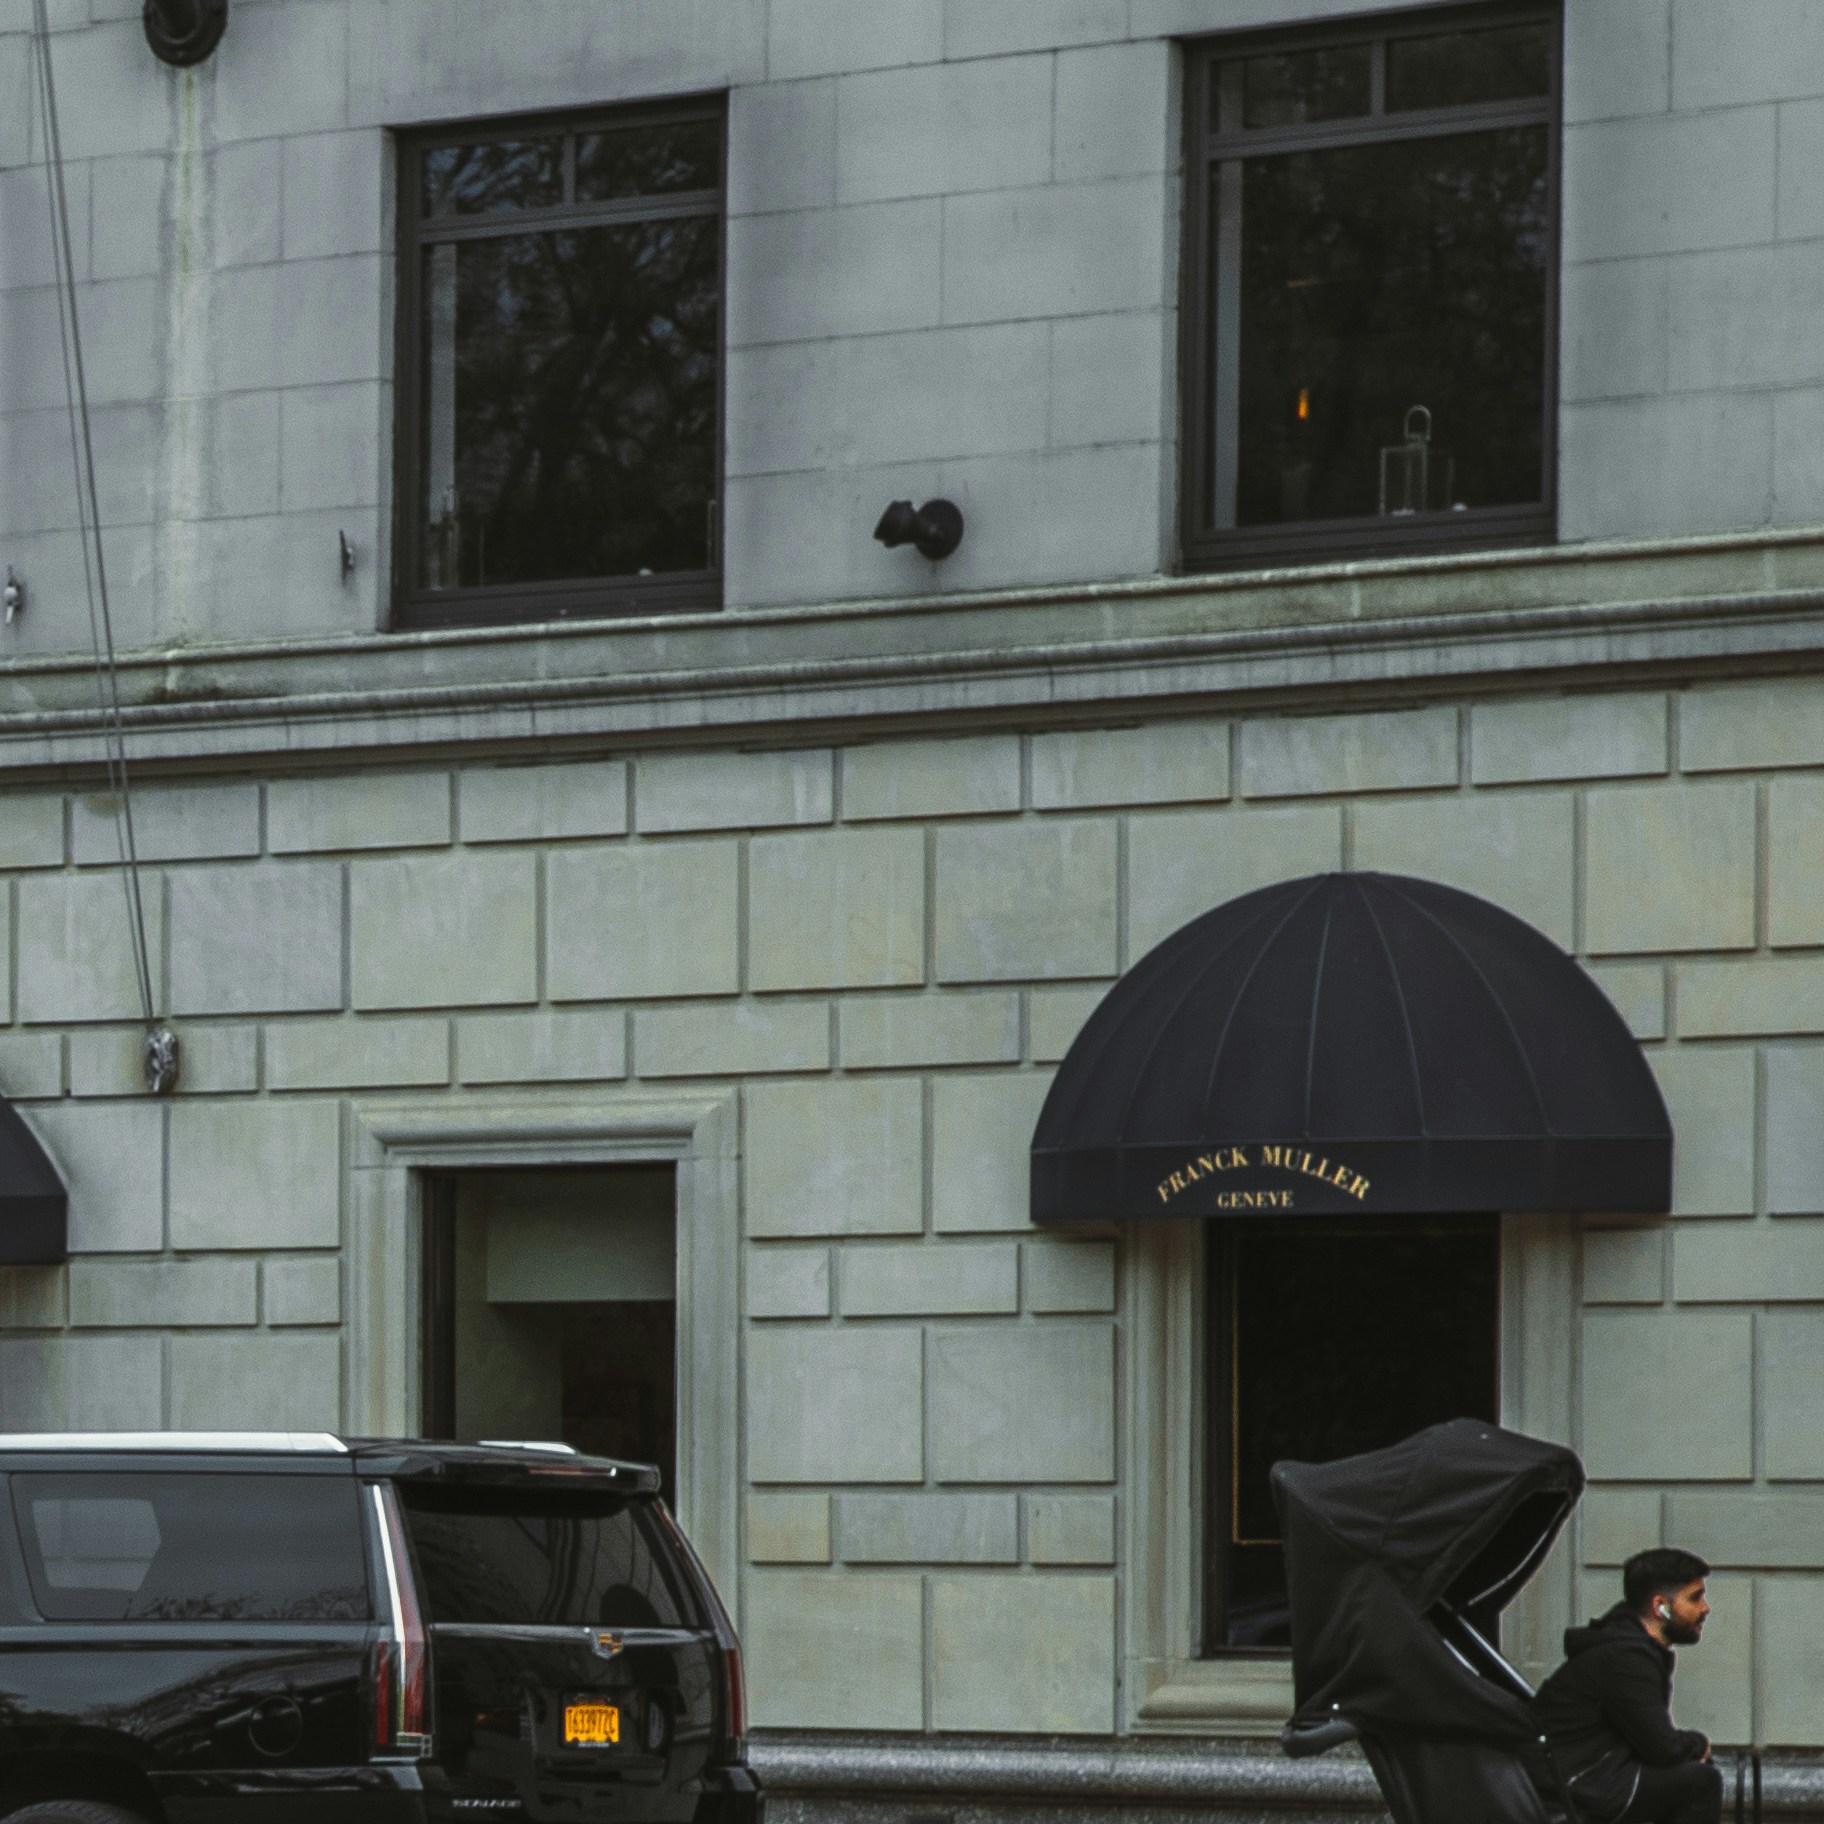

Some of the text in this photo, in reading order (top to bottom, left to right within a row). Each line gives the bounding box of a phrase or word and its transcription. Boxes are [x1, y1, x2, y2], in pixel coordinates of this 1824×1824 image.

[1157, 1145, 1371, 1203] FRANCK MULLER
[1217, 1190, 1295, 1209] GENEVE
